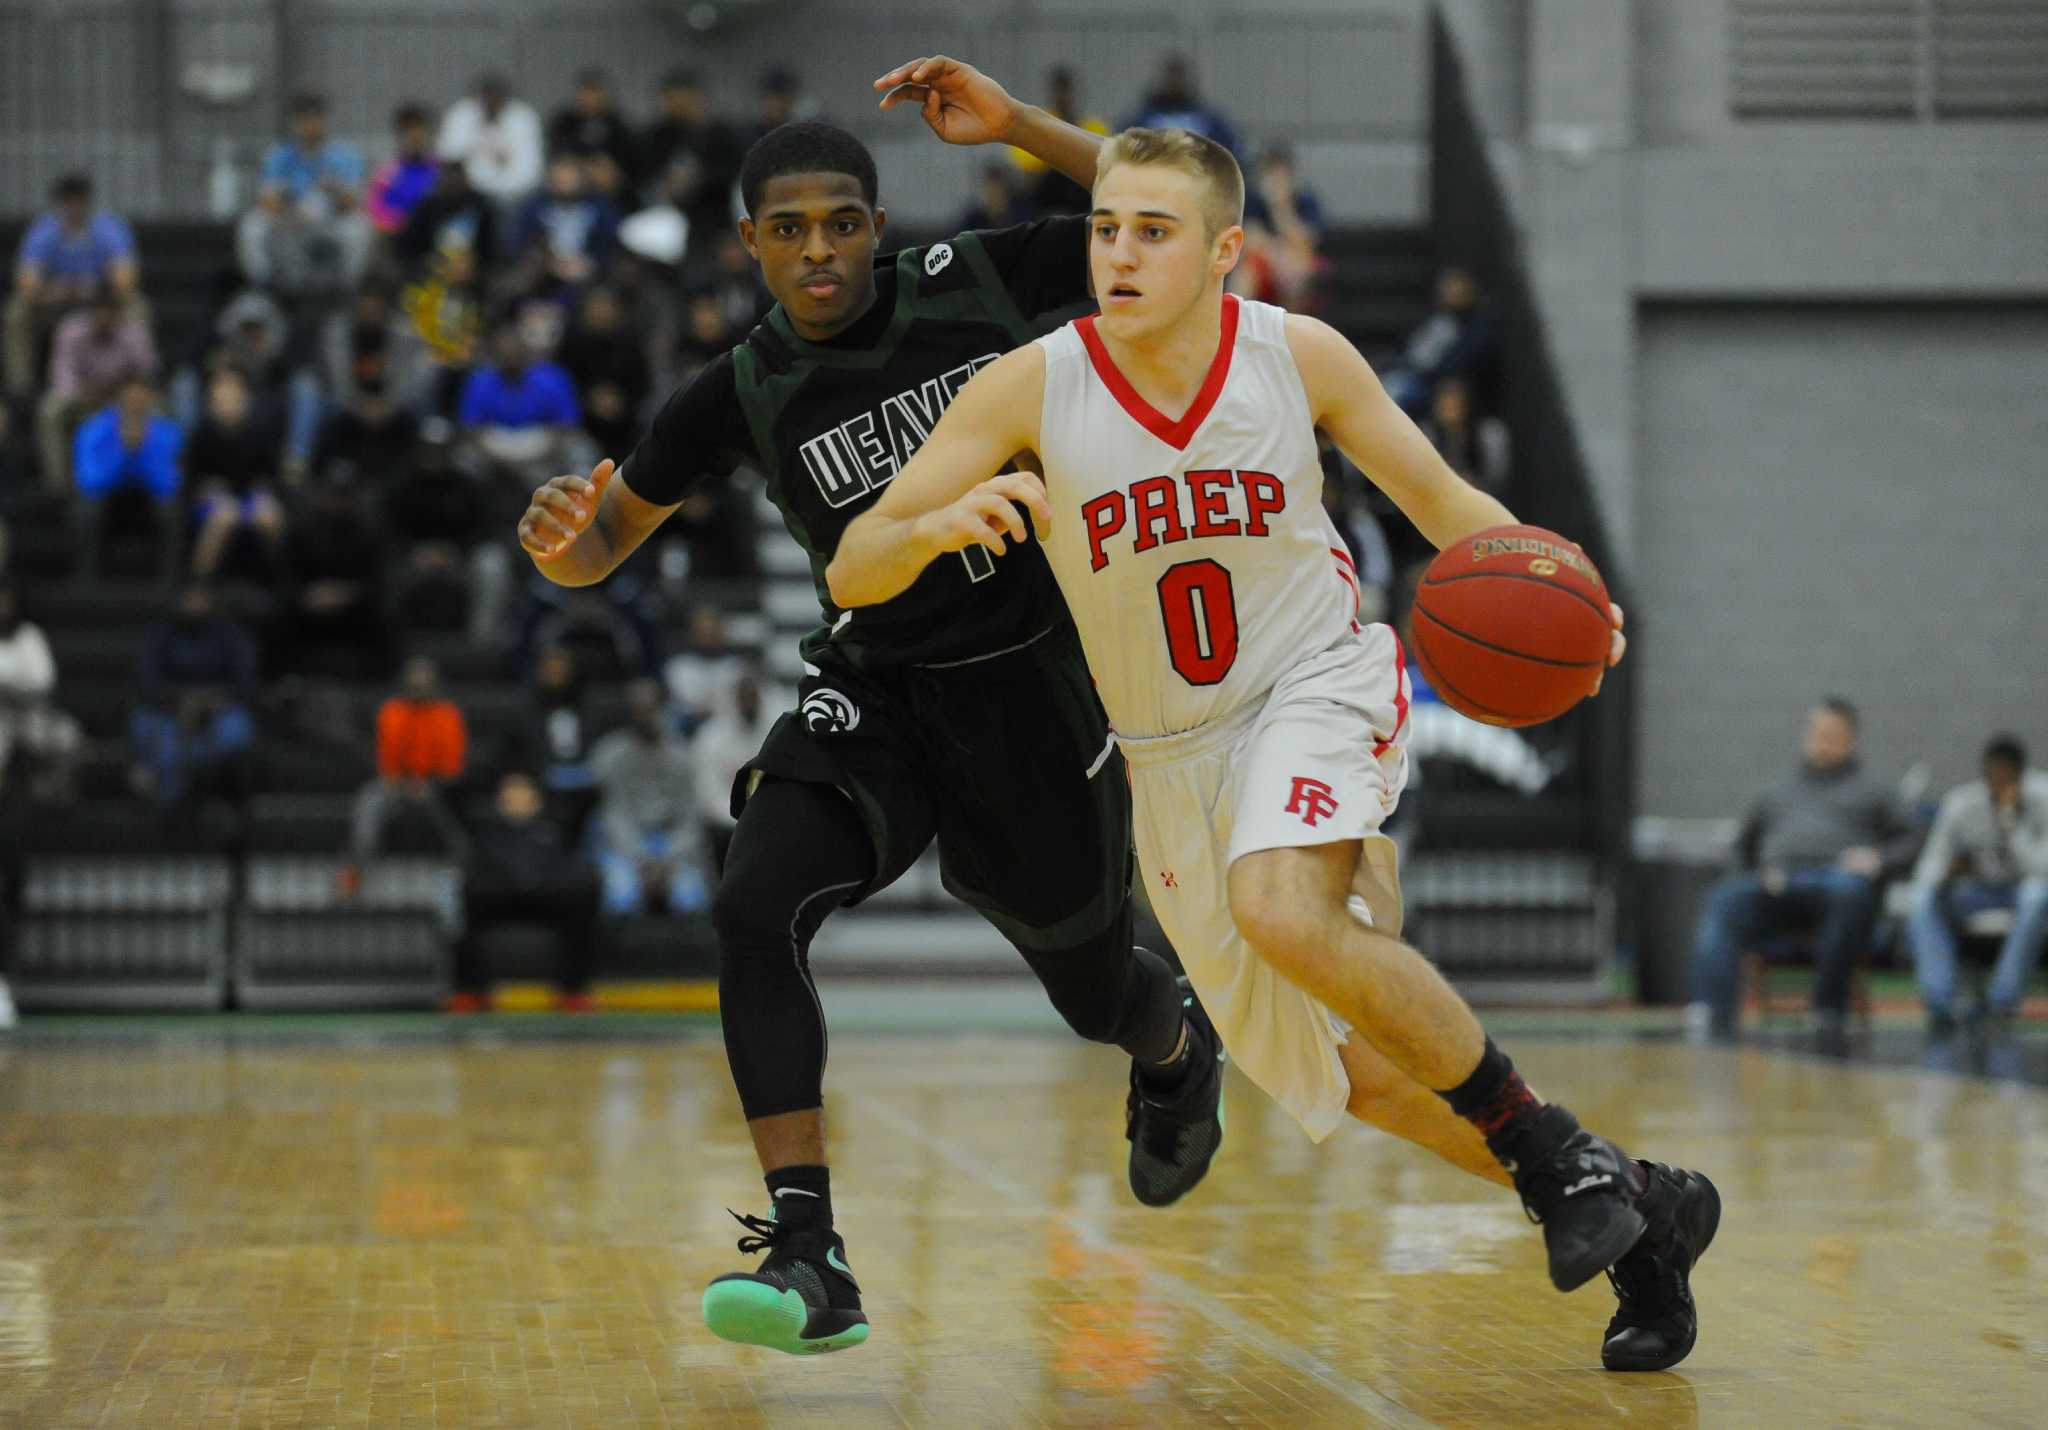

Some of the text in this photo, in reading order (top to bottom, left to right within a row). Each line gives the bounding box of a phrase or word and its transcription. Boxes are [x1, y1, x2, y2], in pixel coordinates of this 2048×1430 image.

[799, 352, 1003, 509] WEAV
[1081, 469, 1286, 573] PREP
[1156, 557, 1239, 686] 0
